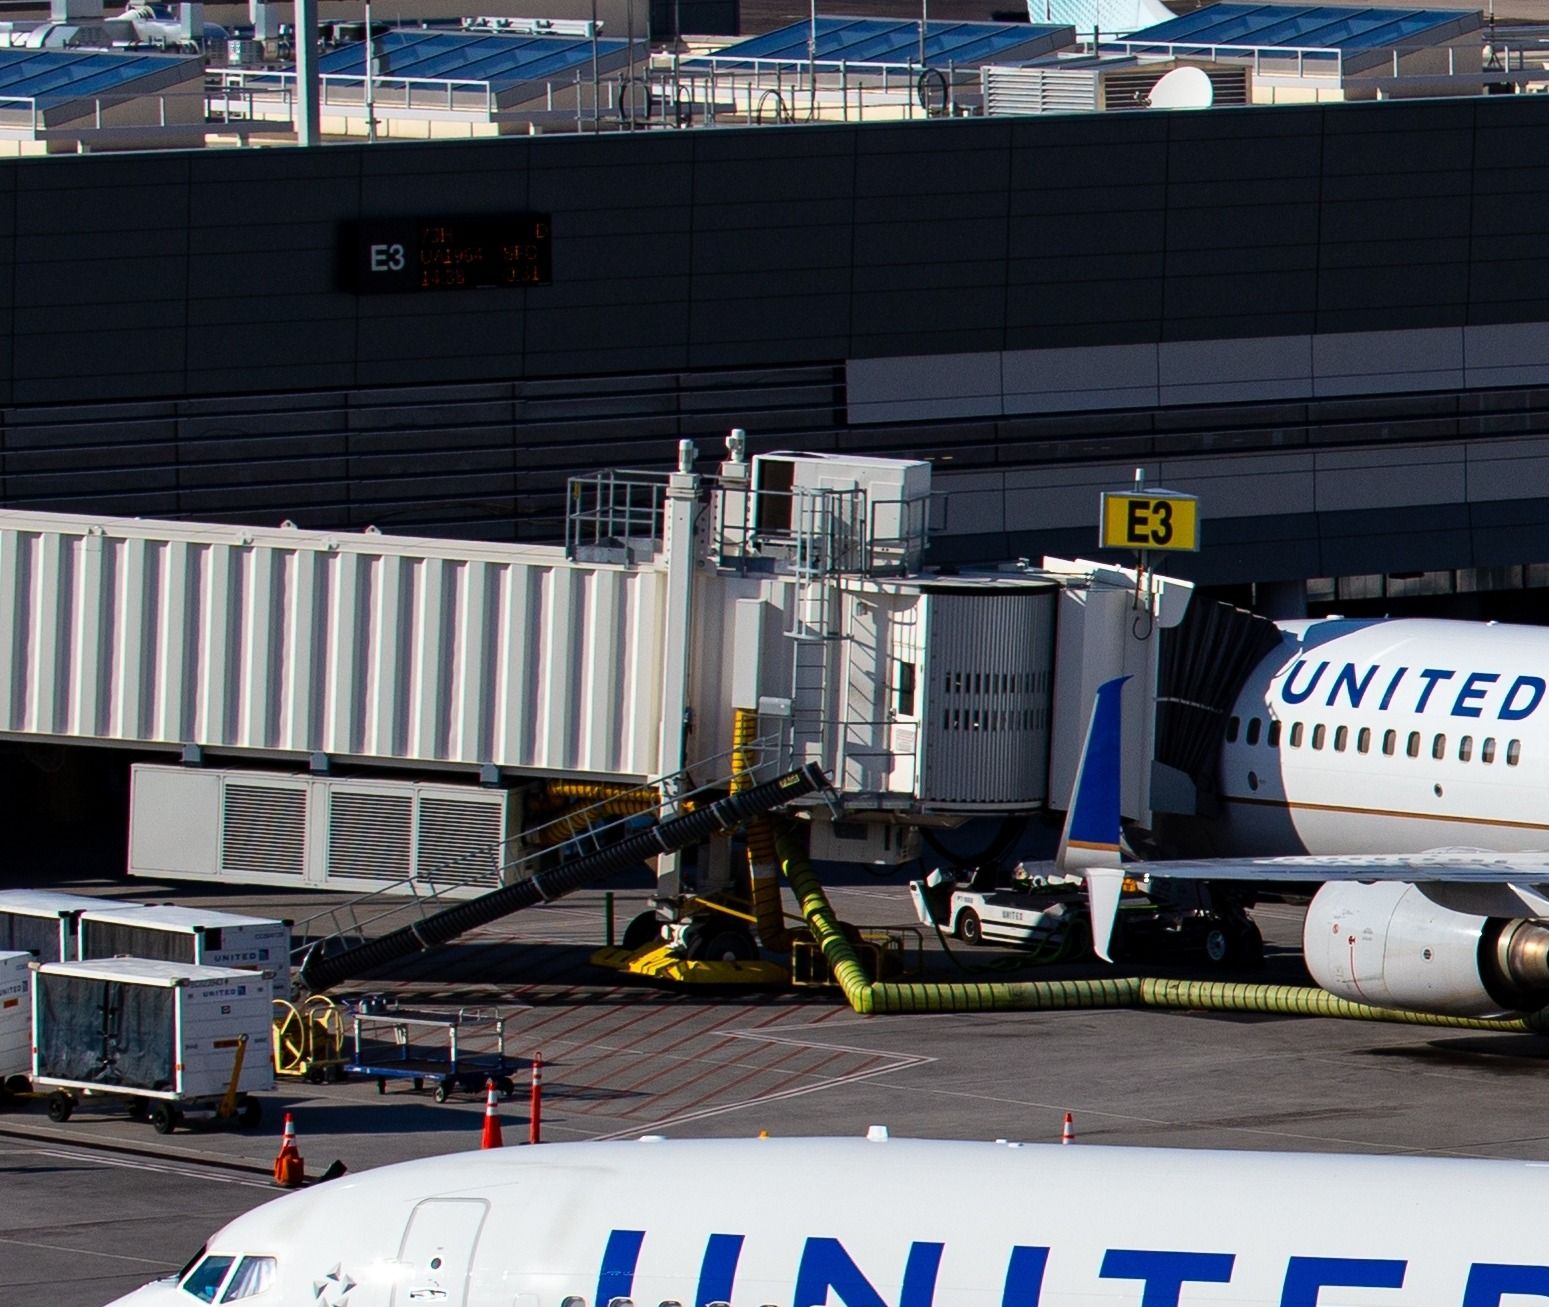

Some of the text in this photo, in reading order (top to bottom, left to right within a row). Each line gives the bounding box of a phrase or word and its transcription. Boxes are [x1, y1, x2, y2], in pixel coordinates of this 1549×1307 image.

[370, 243, 406, 272] E3
[1127, 500, 1173, 545] E3
[1281, 660, 1546, 721] UNITED
[214, 952, 257, 962] UNITED
[203, 988, 237, 998] UNITED
